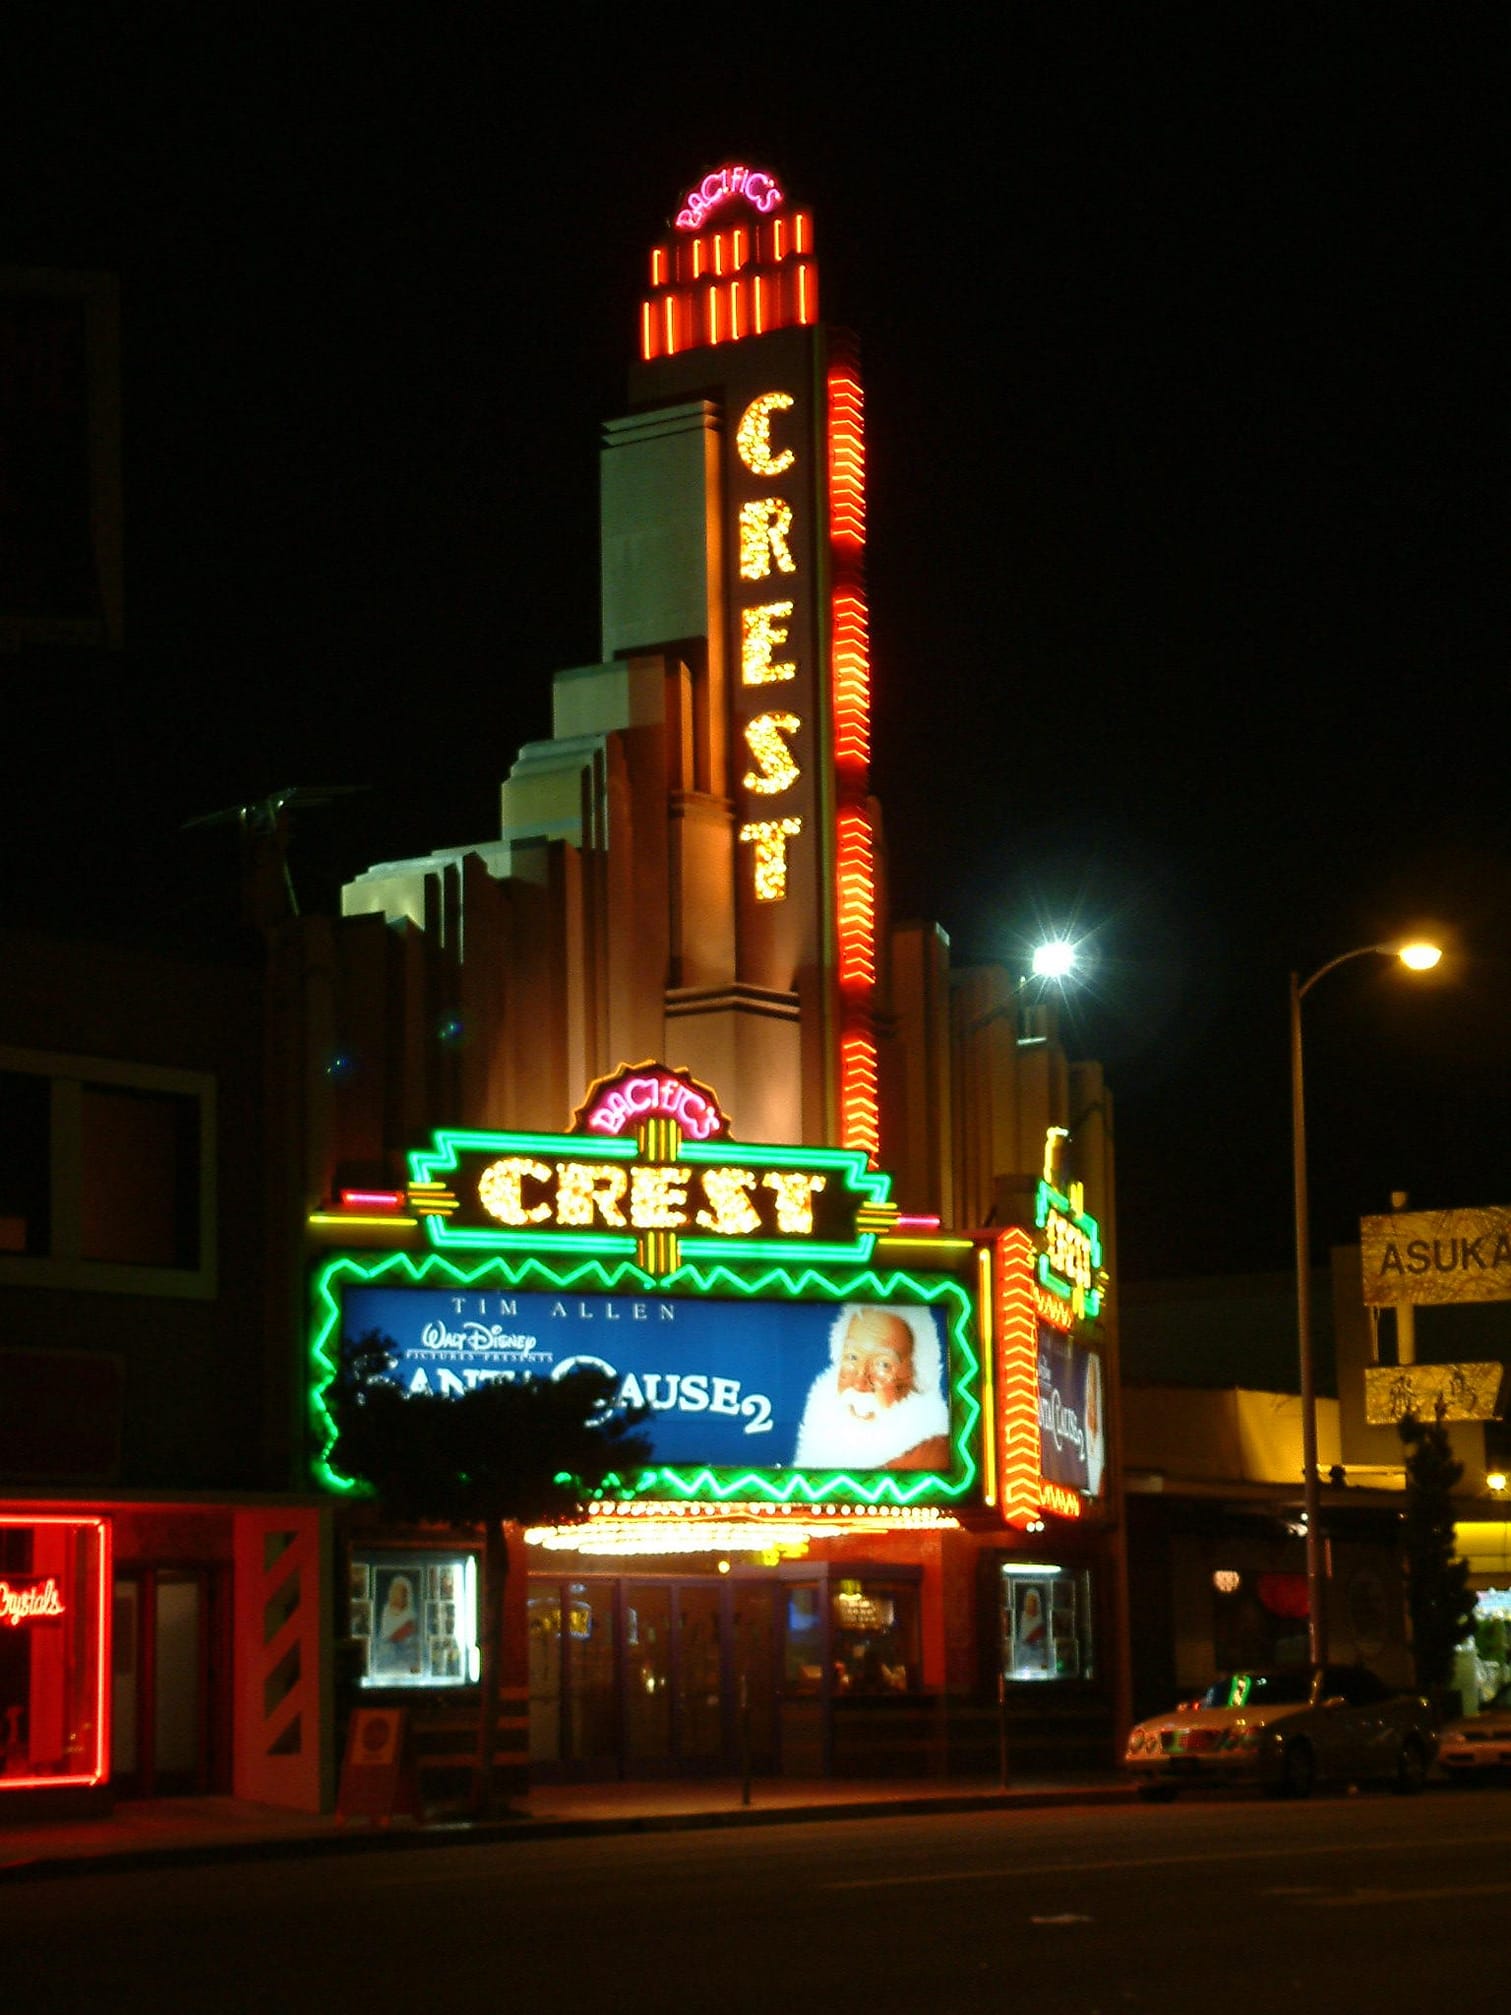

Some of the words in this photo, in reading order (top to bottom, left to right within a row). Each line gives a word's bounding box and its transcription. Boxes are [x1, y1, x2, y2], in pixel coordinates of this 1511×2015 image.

[674, 166, 781, 229] PACIFIC'S
[735, 391, 803, 902] CREST
[593, 1077, 723, 1140] PACIFIC'S
[477, 1156, 827, 1235] CREST
[1380, 1236, 1511, 1277] ASUKA
[452, 1297, 518, 1316] TIM
[552, 1301, 675, 1321] ALLEN
[406, 1351, 475, 1362] PICTURES
[484, 1352, 554, 1364] PRESENTS
